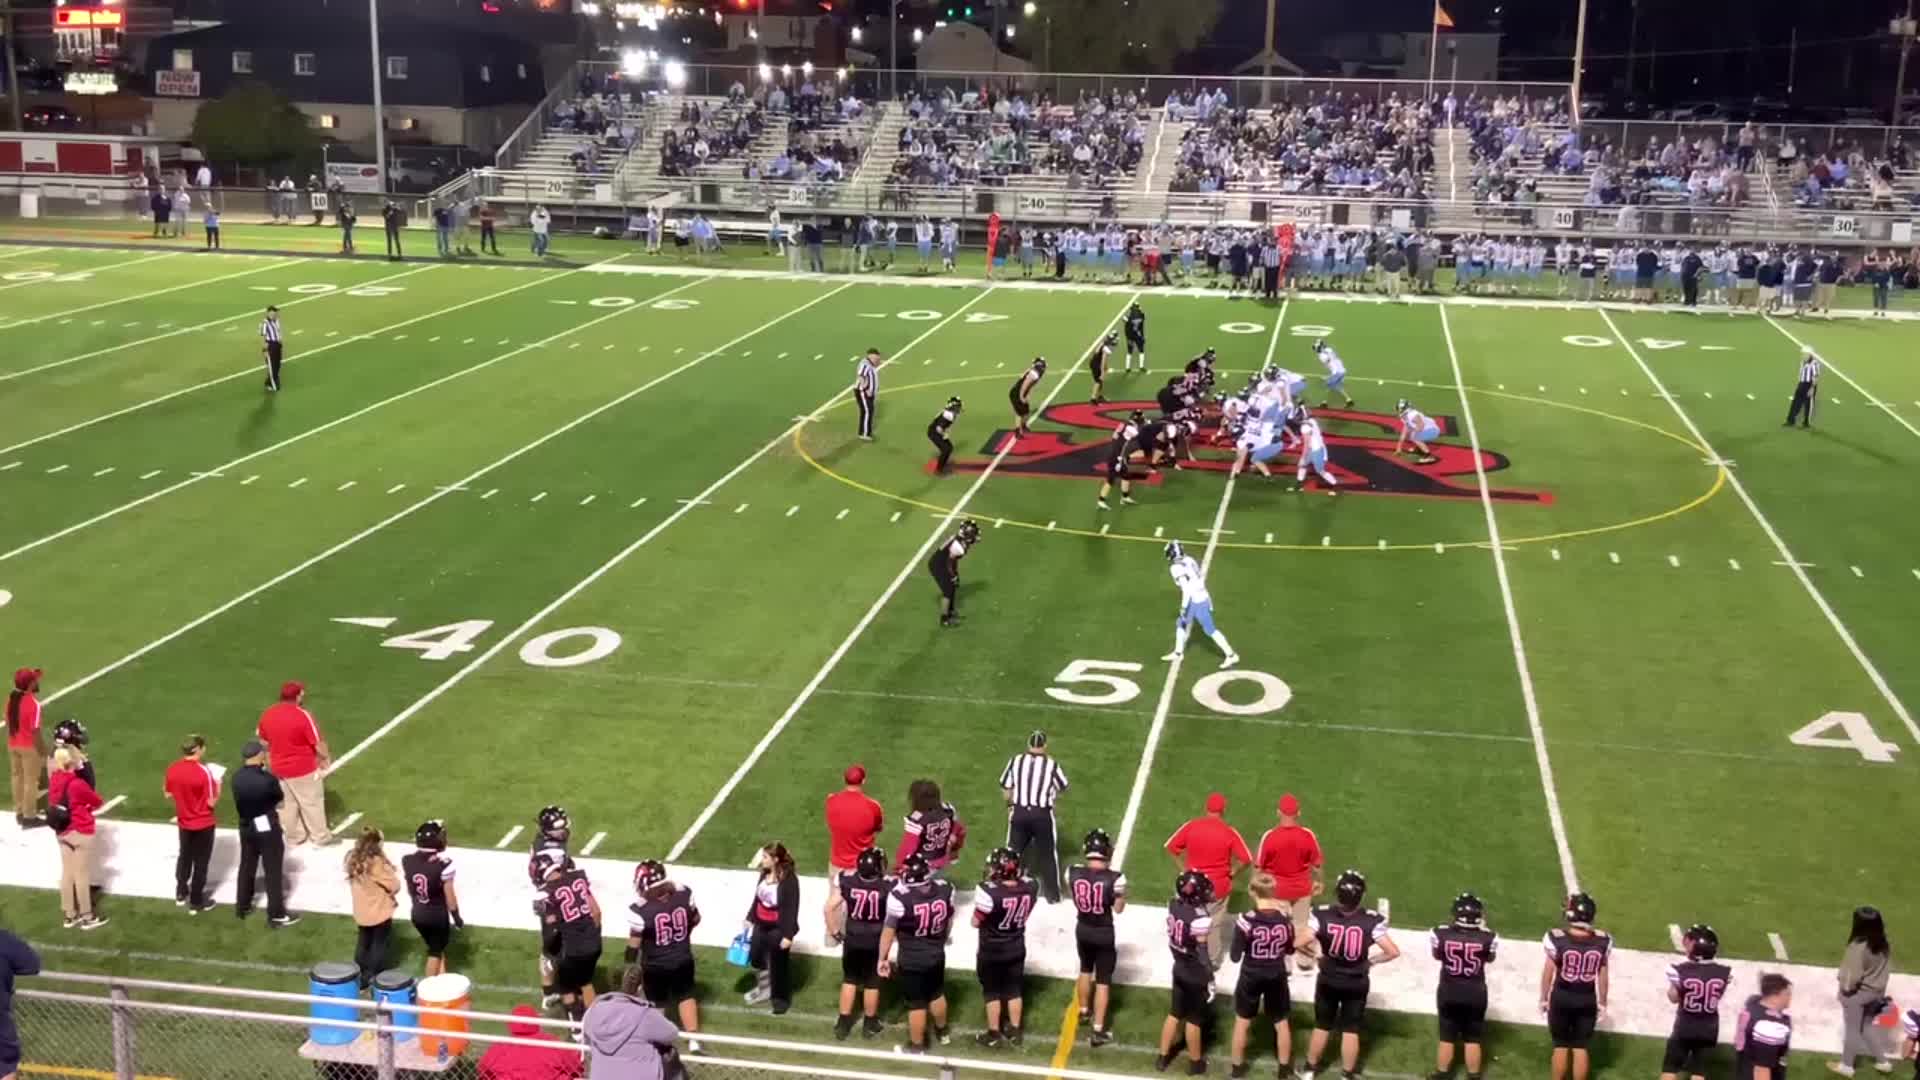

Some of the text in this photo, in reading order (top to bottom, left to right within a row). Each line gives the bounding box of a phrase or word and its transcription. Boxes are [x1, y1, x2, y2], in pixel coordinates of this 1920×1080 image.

[159, 84, 198, 94] OPEN
[160, 73, 196, 83] NOW
[313, 195, 326, 208] 10
[548, 182, 560, 192] 20
[1296, 206, 1311, 217] 50
[1835, 220, 1852, 232] 30
[1788, 691, 1901, 762] 4
[411, 873, 429, 905] 3
[555, 878, 592, 922] 23
[850, 888, 880, 921] 71
[1073, 879, 1105, 915] 81
[654, 906, 689, 947] 69
[913, 899, 948, 937] 72
[999, 894, 1031, 930] 74
[1251, 924, 1288, 960] 22
[1327, 923, 1364, 961] 70
[1444, 940, 1484, 977] 55
[1561, 950, 1601, 982] 80
[1683, 977, 1727, 1014] 26
